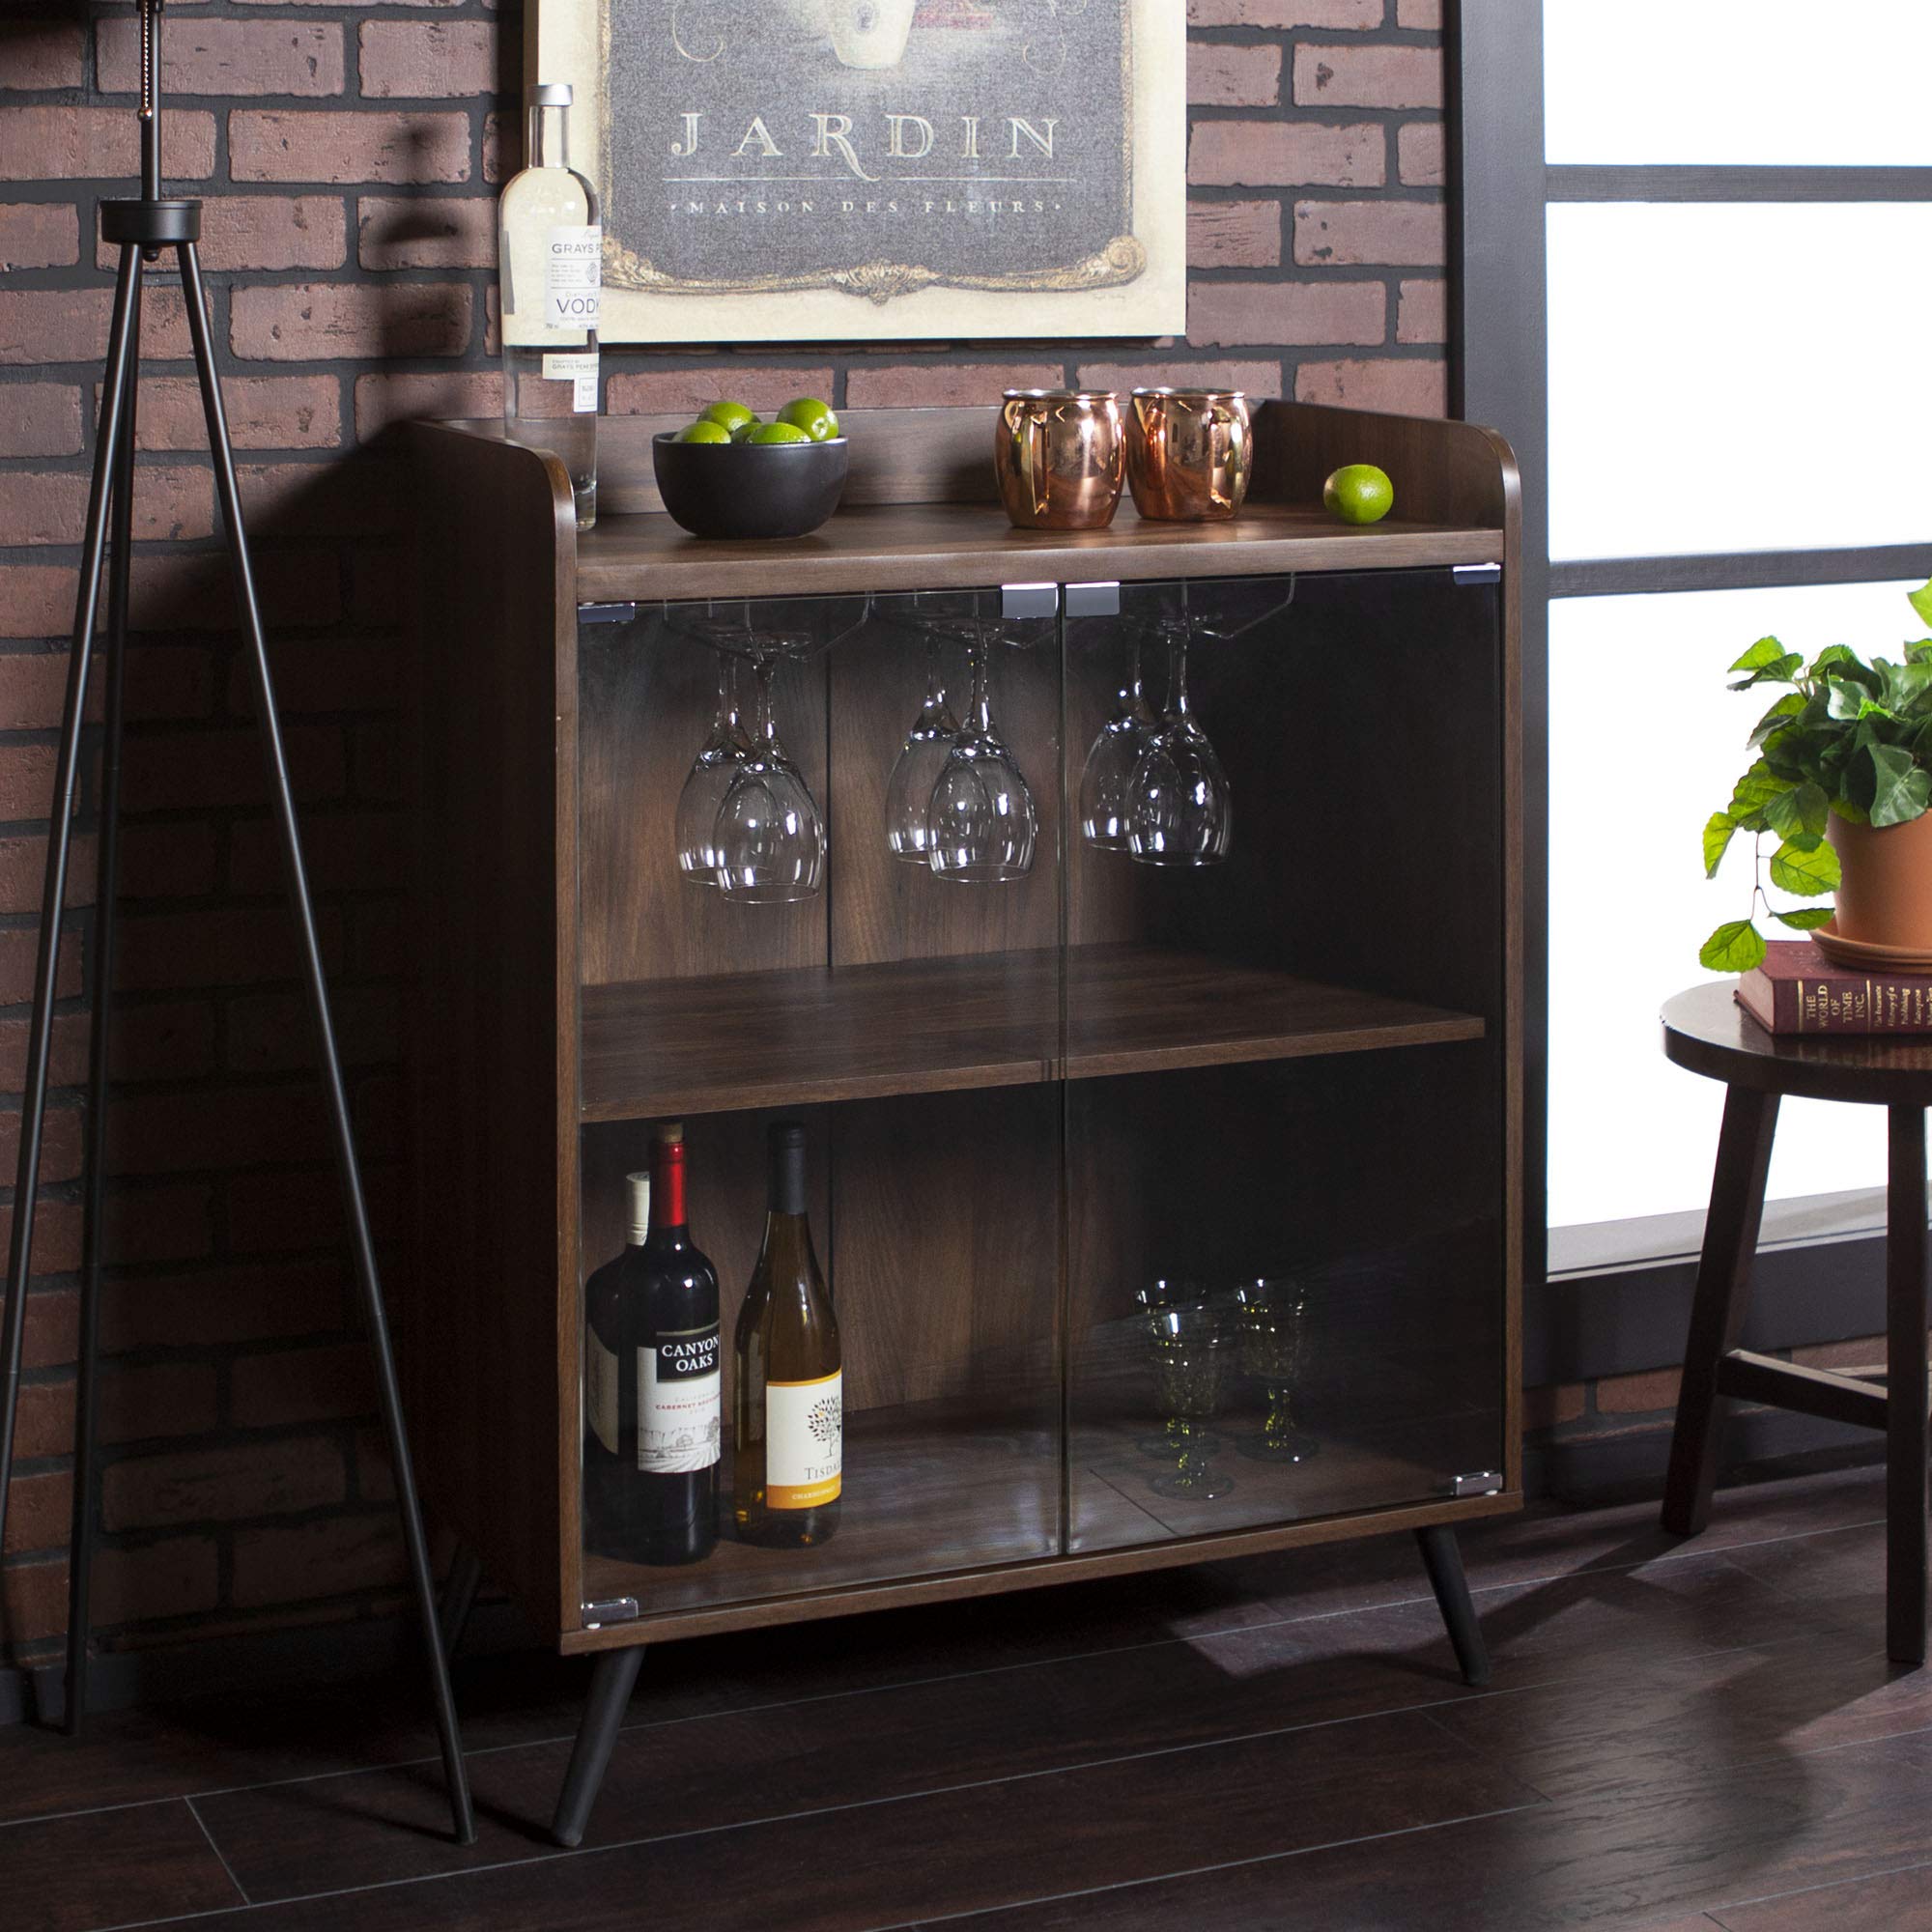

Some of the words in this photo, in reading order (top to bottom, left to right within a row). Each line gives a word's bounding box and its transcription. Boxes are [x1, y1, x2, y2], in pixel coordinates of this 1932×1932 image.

[671, 113, 1059, 182] JARDIN
[690, 201, 813, 213] MAISON
[841, 201, 897, 213] DES
[924, 201, 1044, 213] FLEURS
[552, 243, 594, 254] GRAYS
[1805, 995, 1817, 1020] THE
[1817, 984, 1830, 1029] WORLD
[1831, 998, 1841, 1016] OF
[1842, 991, 1854, 1023] TIME
[661, 1334, 719, 1357] CANYON
[676, 1352, 714, 1372] OAKS
